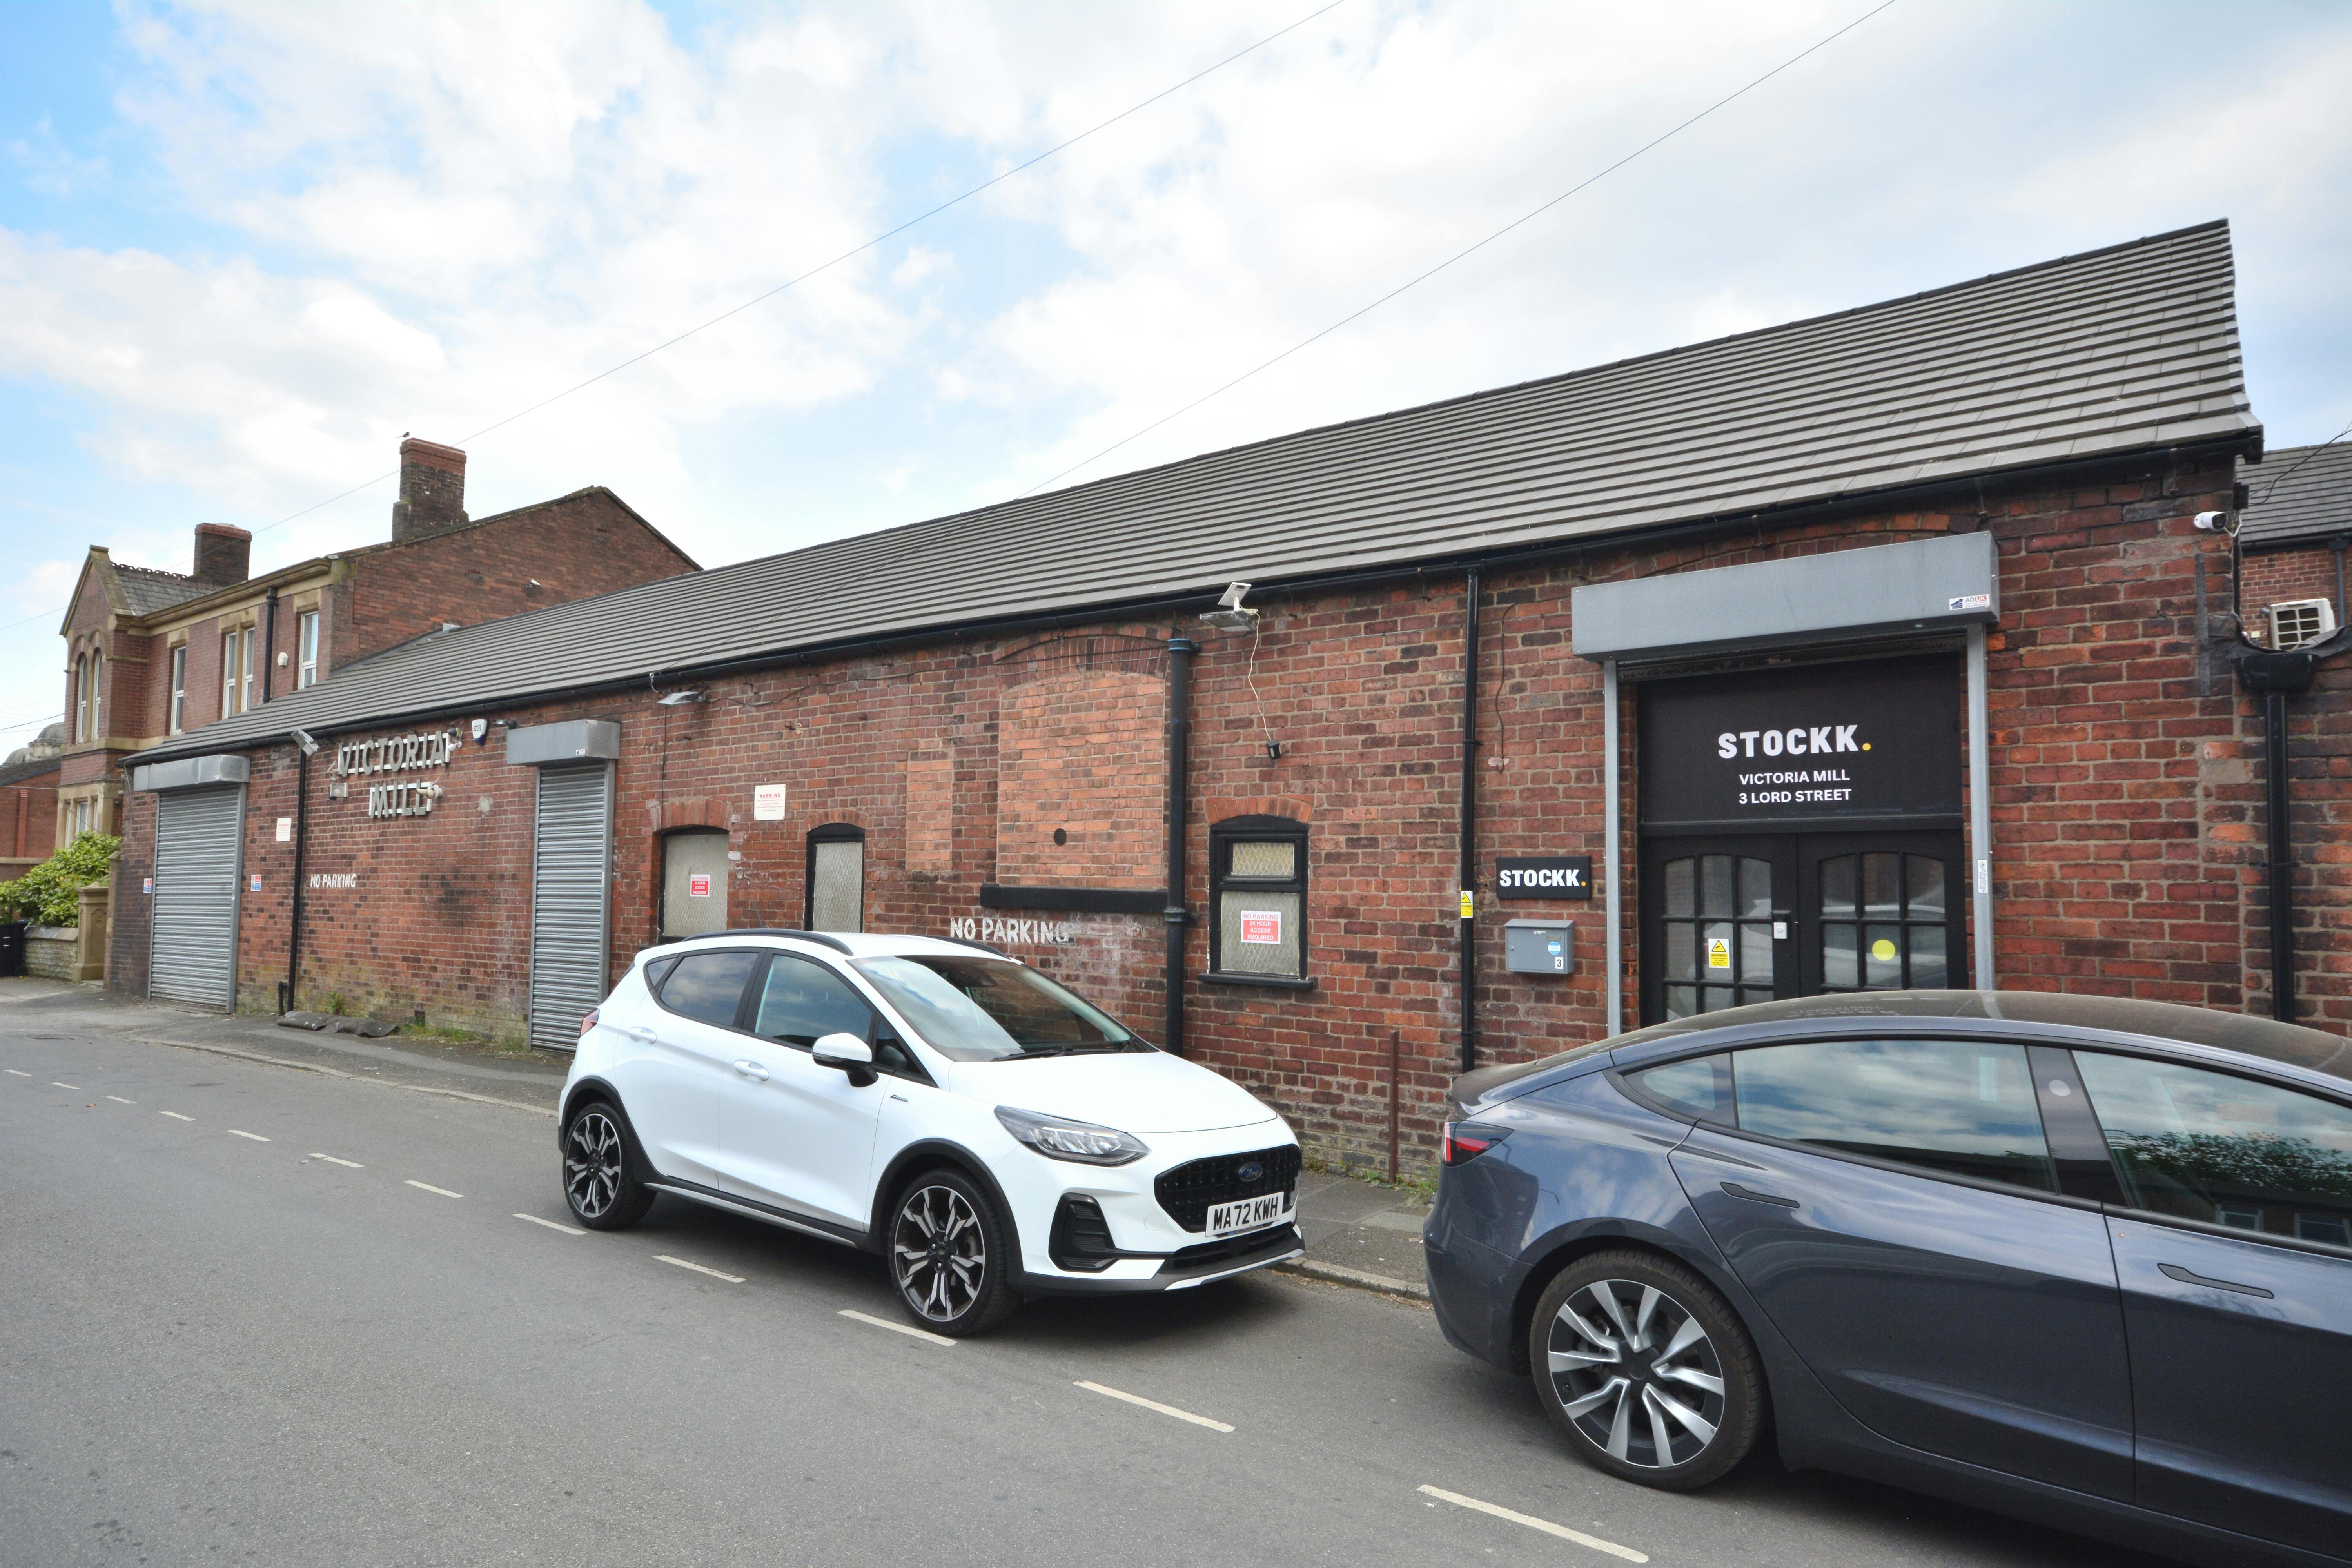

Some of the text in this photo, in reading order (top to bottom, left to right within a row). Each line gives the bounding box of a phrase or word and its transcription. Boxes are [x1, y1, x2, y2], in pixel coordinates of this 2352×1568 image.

[1718, 724, 1871, 759] STOCKK.
[338, 730, 445, 777] VICTORIA
[1739, 769, 1850, 785] VICTORIA MILL
[370, 779, 426, 818] MILL
[1739, 789, 1852, 804] 3 LORD STREET
[310, 873, 356, 889] NO PARKING
[1499, 869, 1586, 887] STOCKK.
[950, 917, 1071, 944] NO PARKING
[1557, 959, 1562, 967] 3
[1213, 1196, 1278, 1231] MA72 KWH
